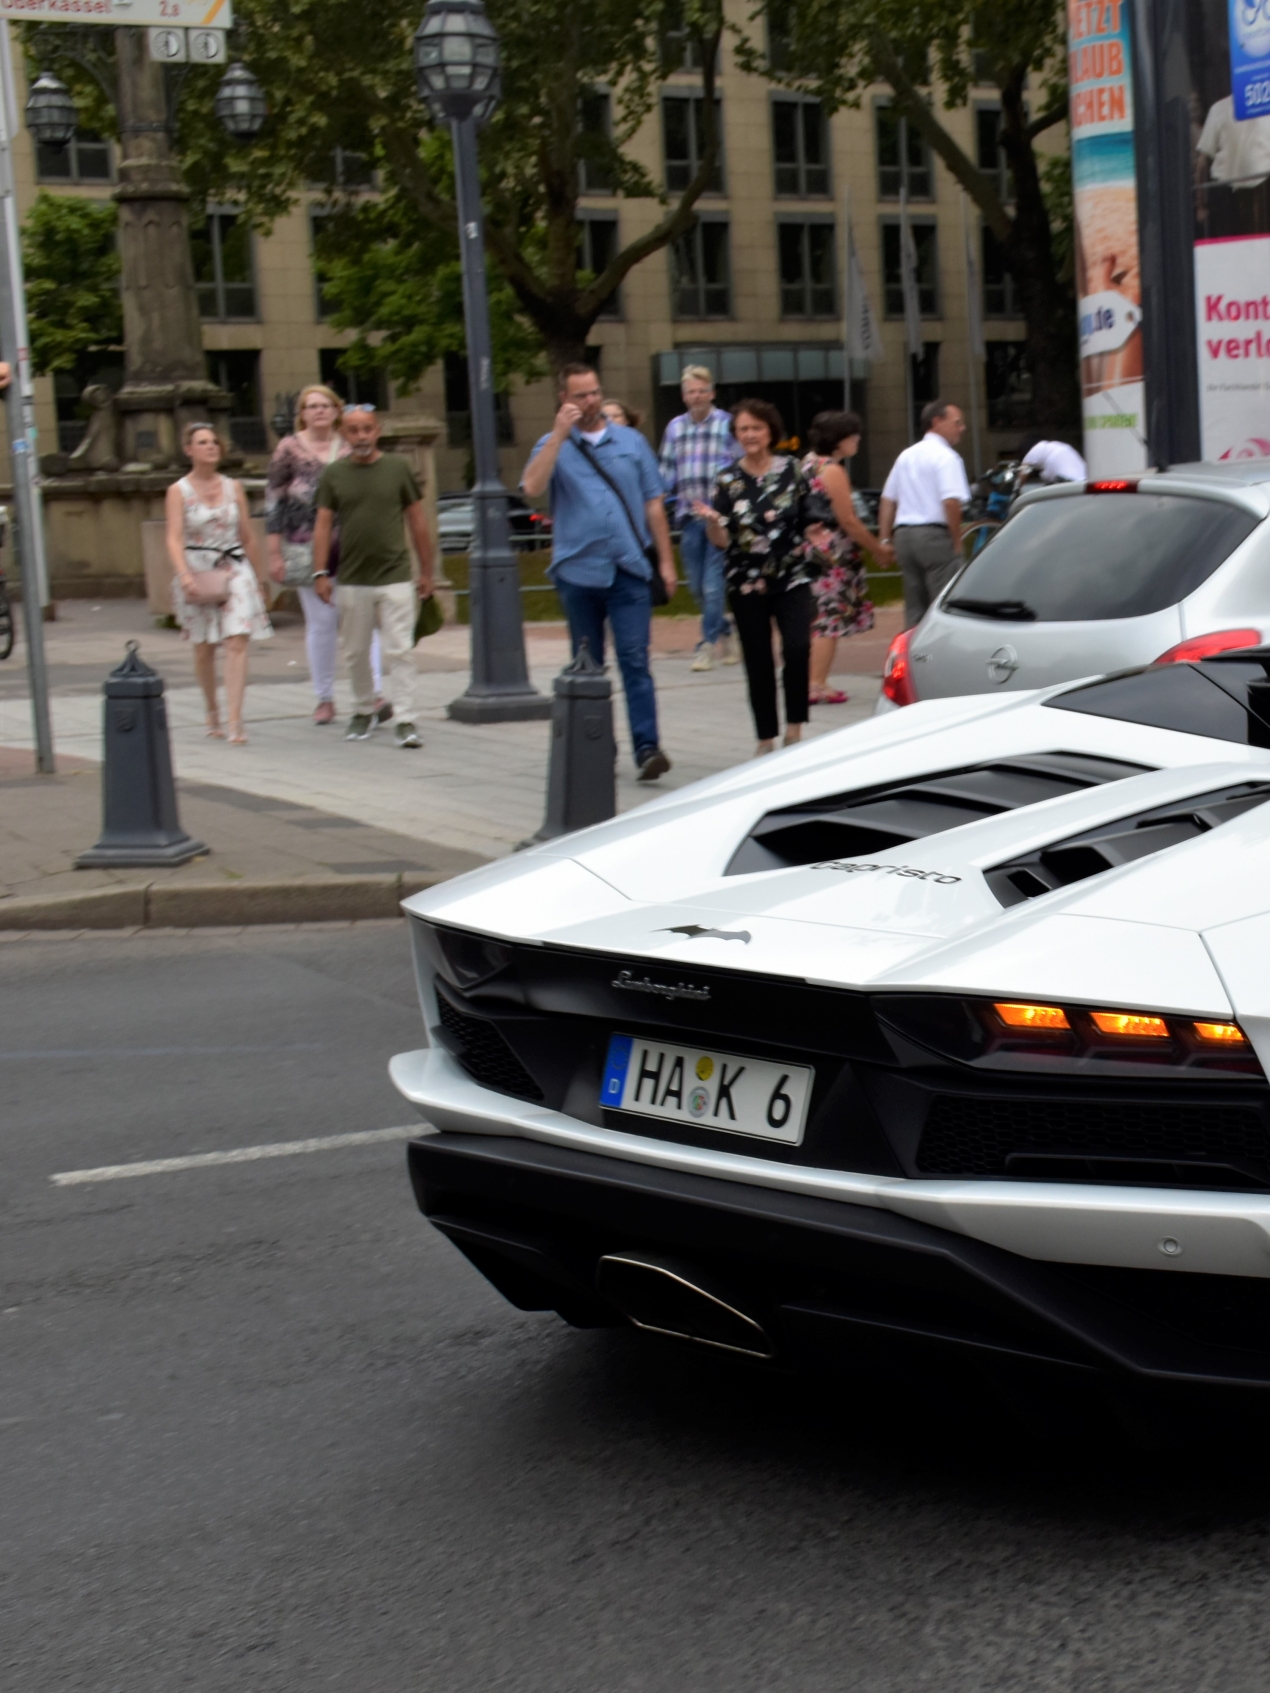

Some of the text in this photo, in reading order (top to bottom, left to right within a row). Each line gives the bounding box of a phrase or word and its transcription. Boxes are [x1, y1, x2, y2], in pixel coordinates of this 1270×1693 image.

[611, 970, 711, 1001] Lamborghini
[608, 1078, 621, 1094] D
[634, 1049, 792, 1128] HA K 6
